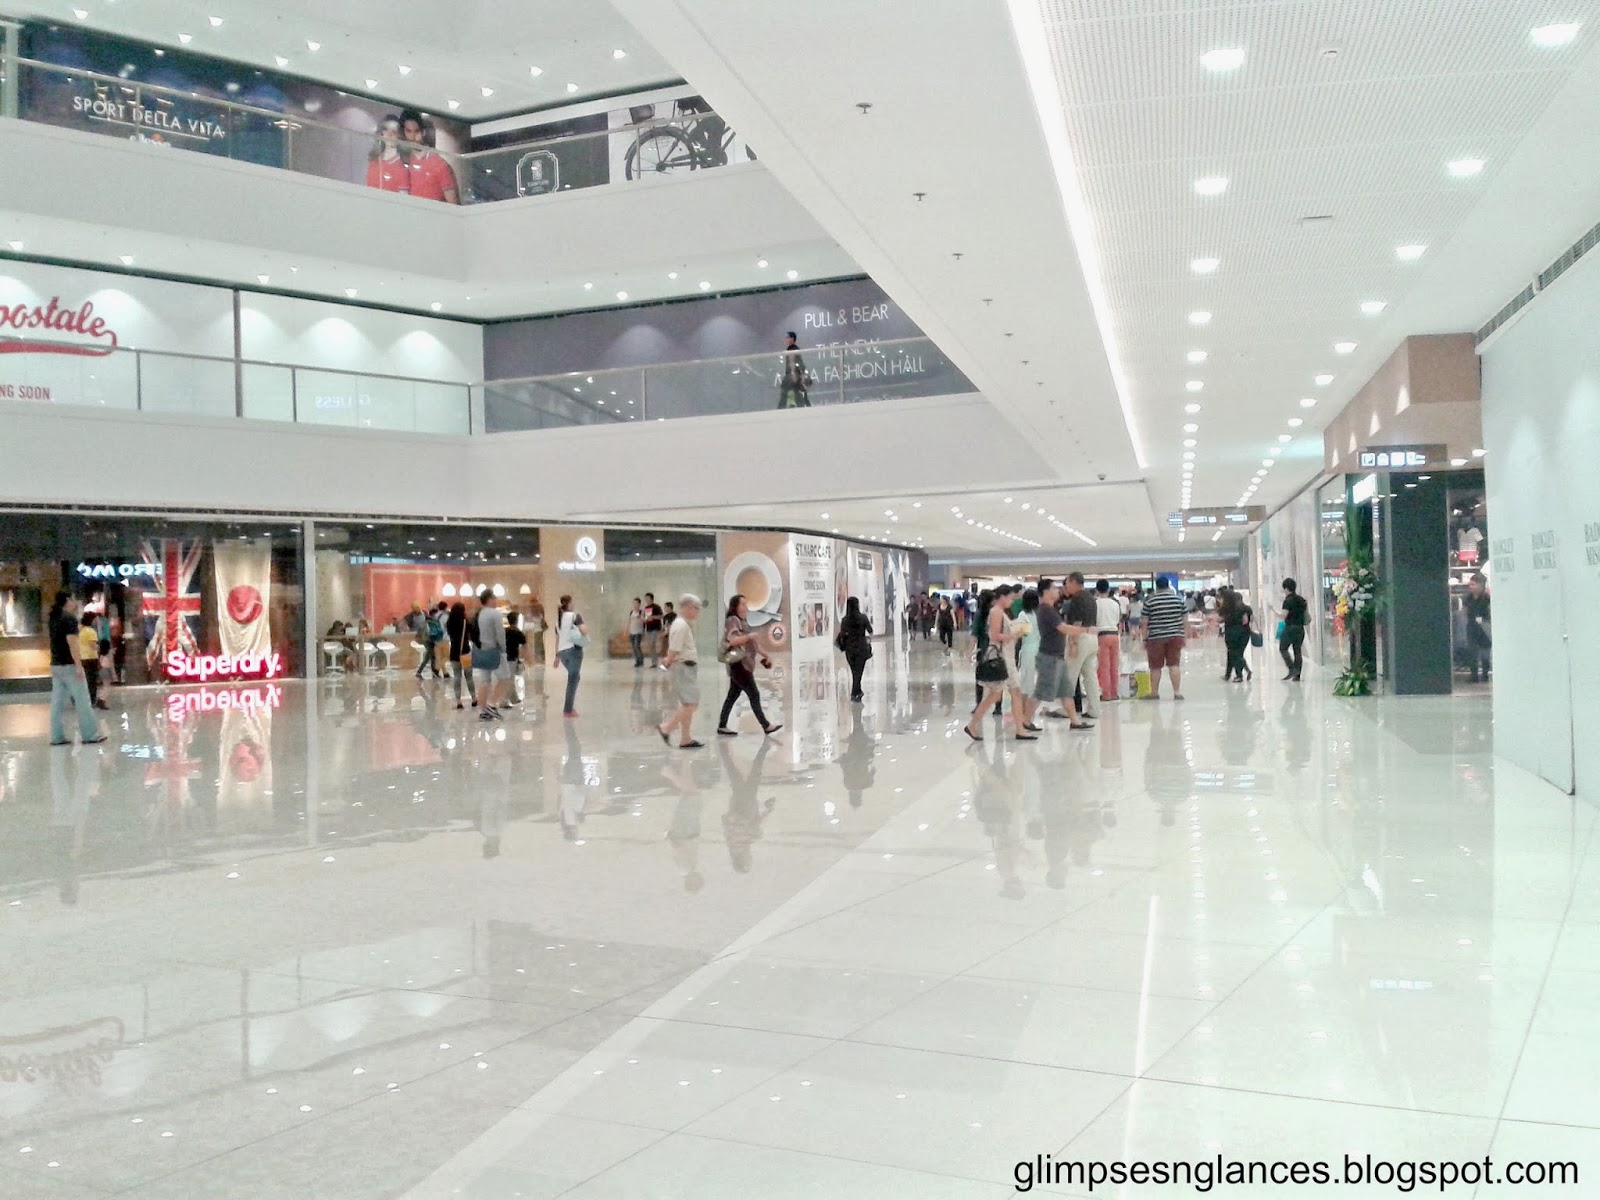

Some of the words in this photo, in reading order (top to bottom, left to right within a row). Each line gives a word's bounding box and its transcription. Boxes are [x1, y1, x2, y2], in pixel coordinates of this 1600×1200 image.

[73, 96, 125, 118] SPORT
[132, 105, 181, 130] DELLA
[804, 311, 833, 329] PULL
[837, 309, 847, 325] &
[852, 304, 889, 323] BEAR
[824, 361, 887, 382] FASHION
[891, 356, 925, 376] HALL
[19, 385, 50, 400] SOON
[167, 649, 282, 681] Superdry.
